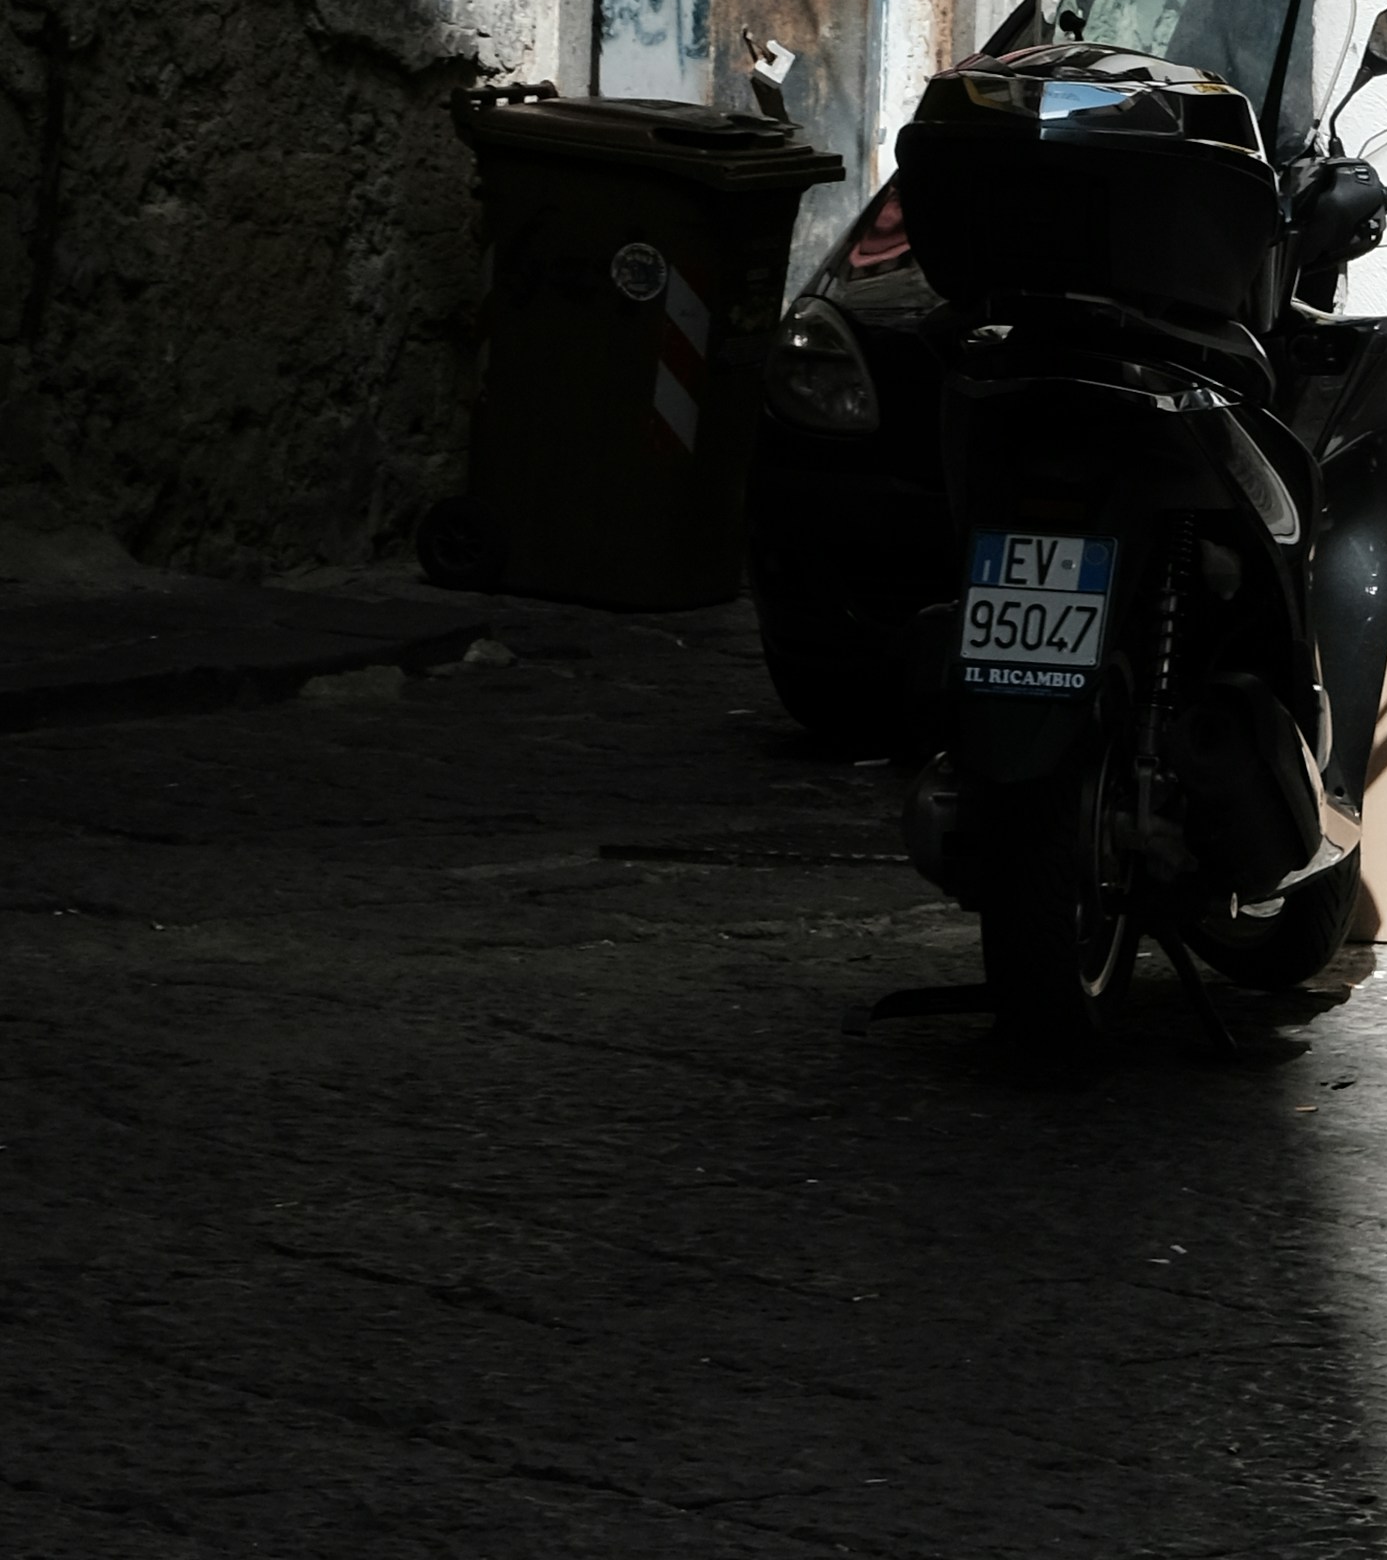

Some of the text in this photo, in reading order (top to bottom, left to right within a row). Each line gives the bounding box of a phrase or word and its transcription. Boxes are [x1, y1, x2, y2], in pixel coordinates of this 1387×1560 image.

[1004, 537, 1059, 587] EV
[969, 599, 1099, 654] 95047
[964, 666, 1086, 689] IL RICAMBIO
